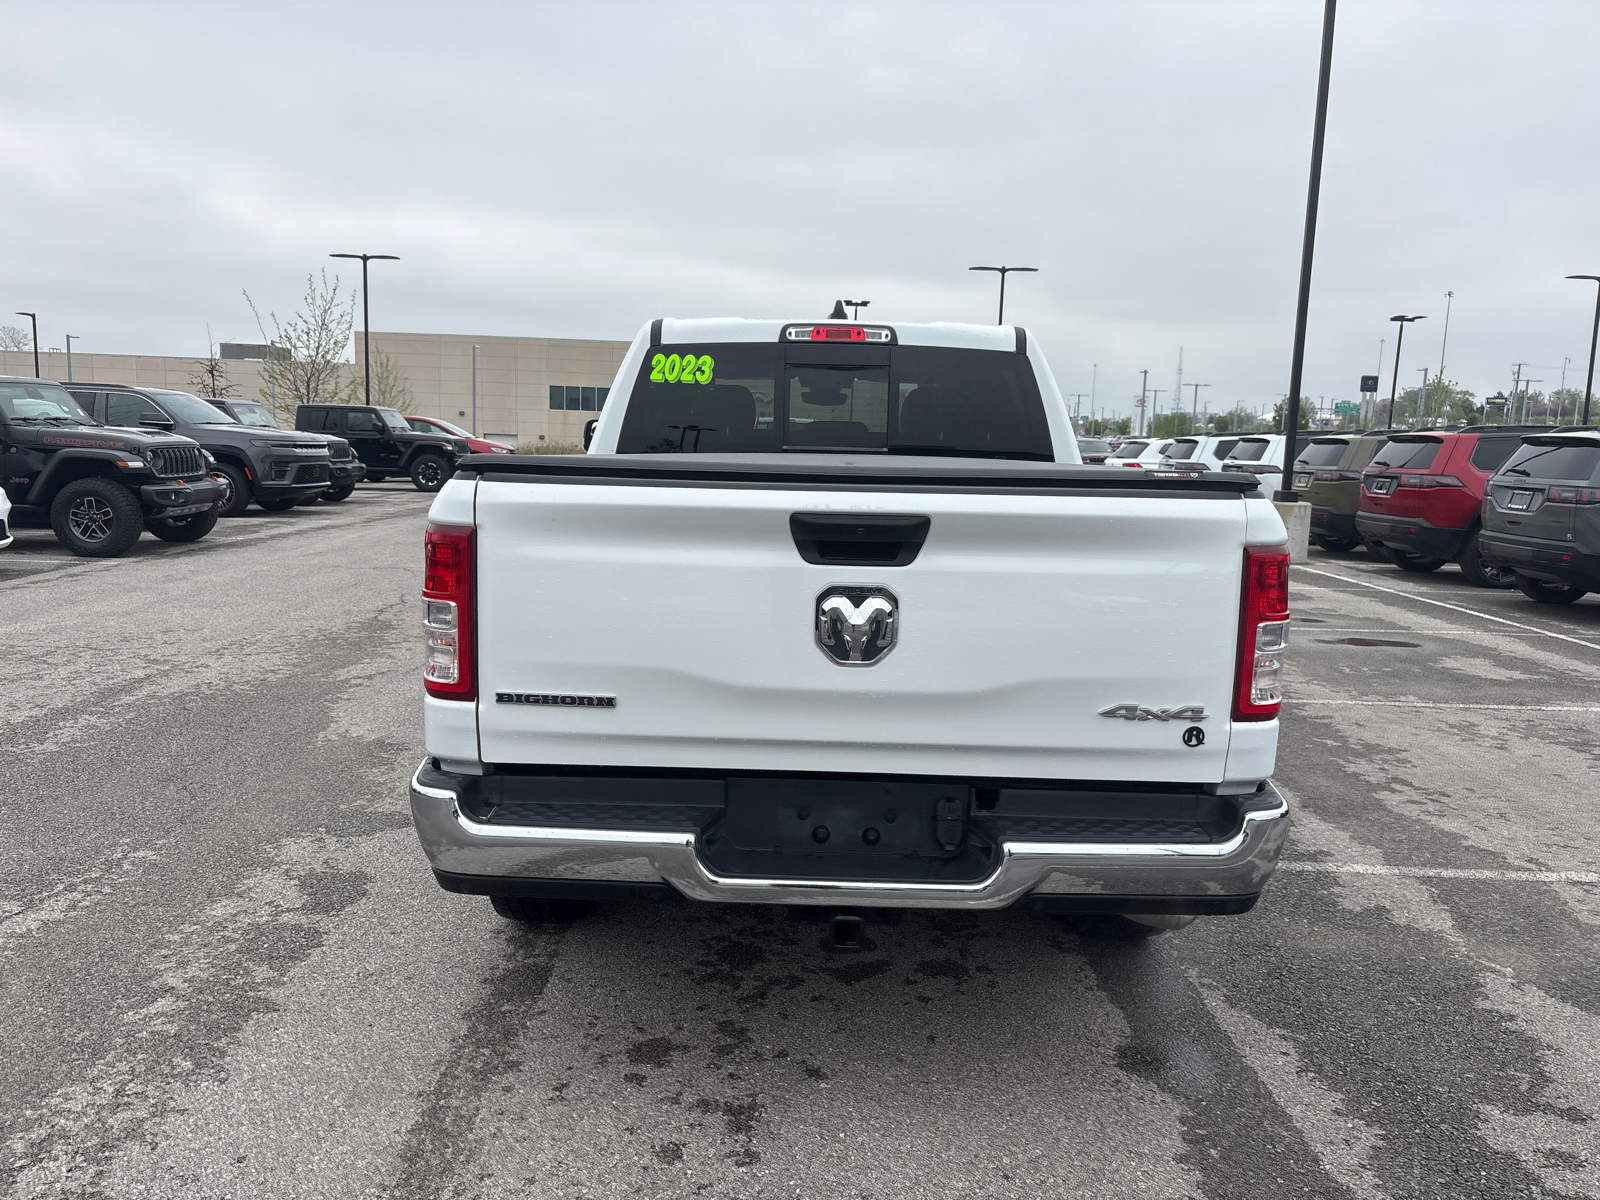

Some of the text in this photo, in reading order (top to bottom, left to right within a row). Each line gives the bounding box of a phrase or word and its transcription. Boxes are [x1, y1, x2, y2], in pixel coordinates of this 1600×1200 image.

[650, 353, 715, 385] 2023
[43, 437, 124, 448] MOJAVE
[10, 476, 29, 484] Jeep
[832, 587, 883, 595] RAM
[495, 692, 616, 708] BIGHORN
[1098, 704, 1209, 722] 4x4
